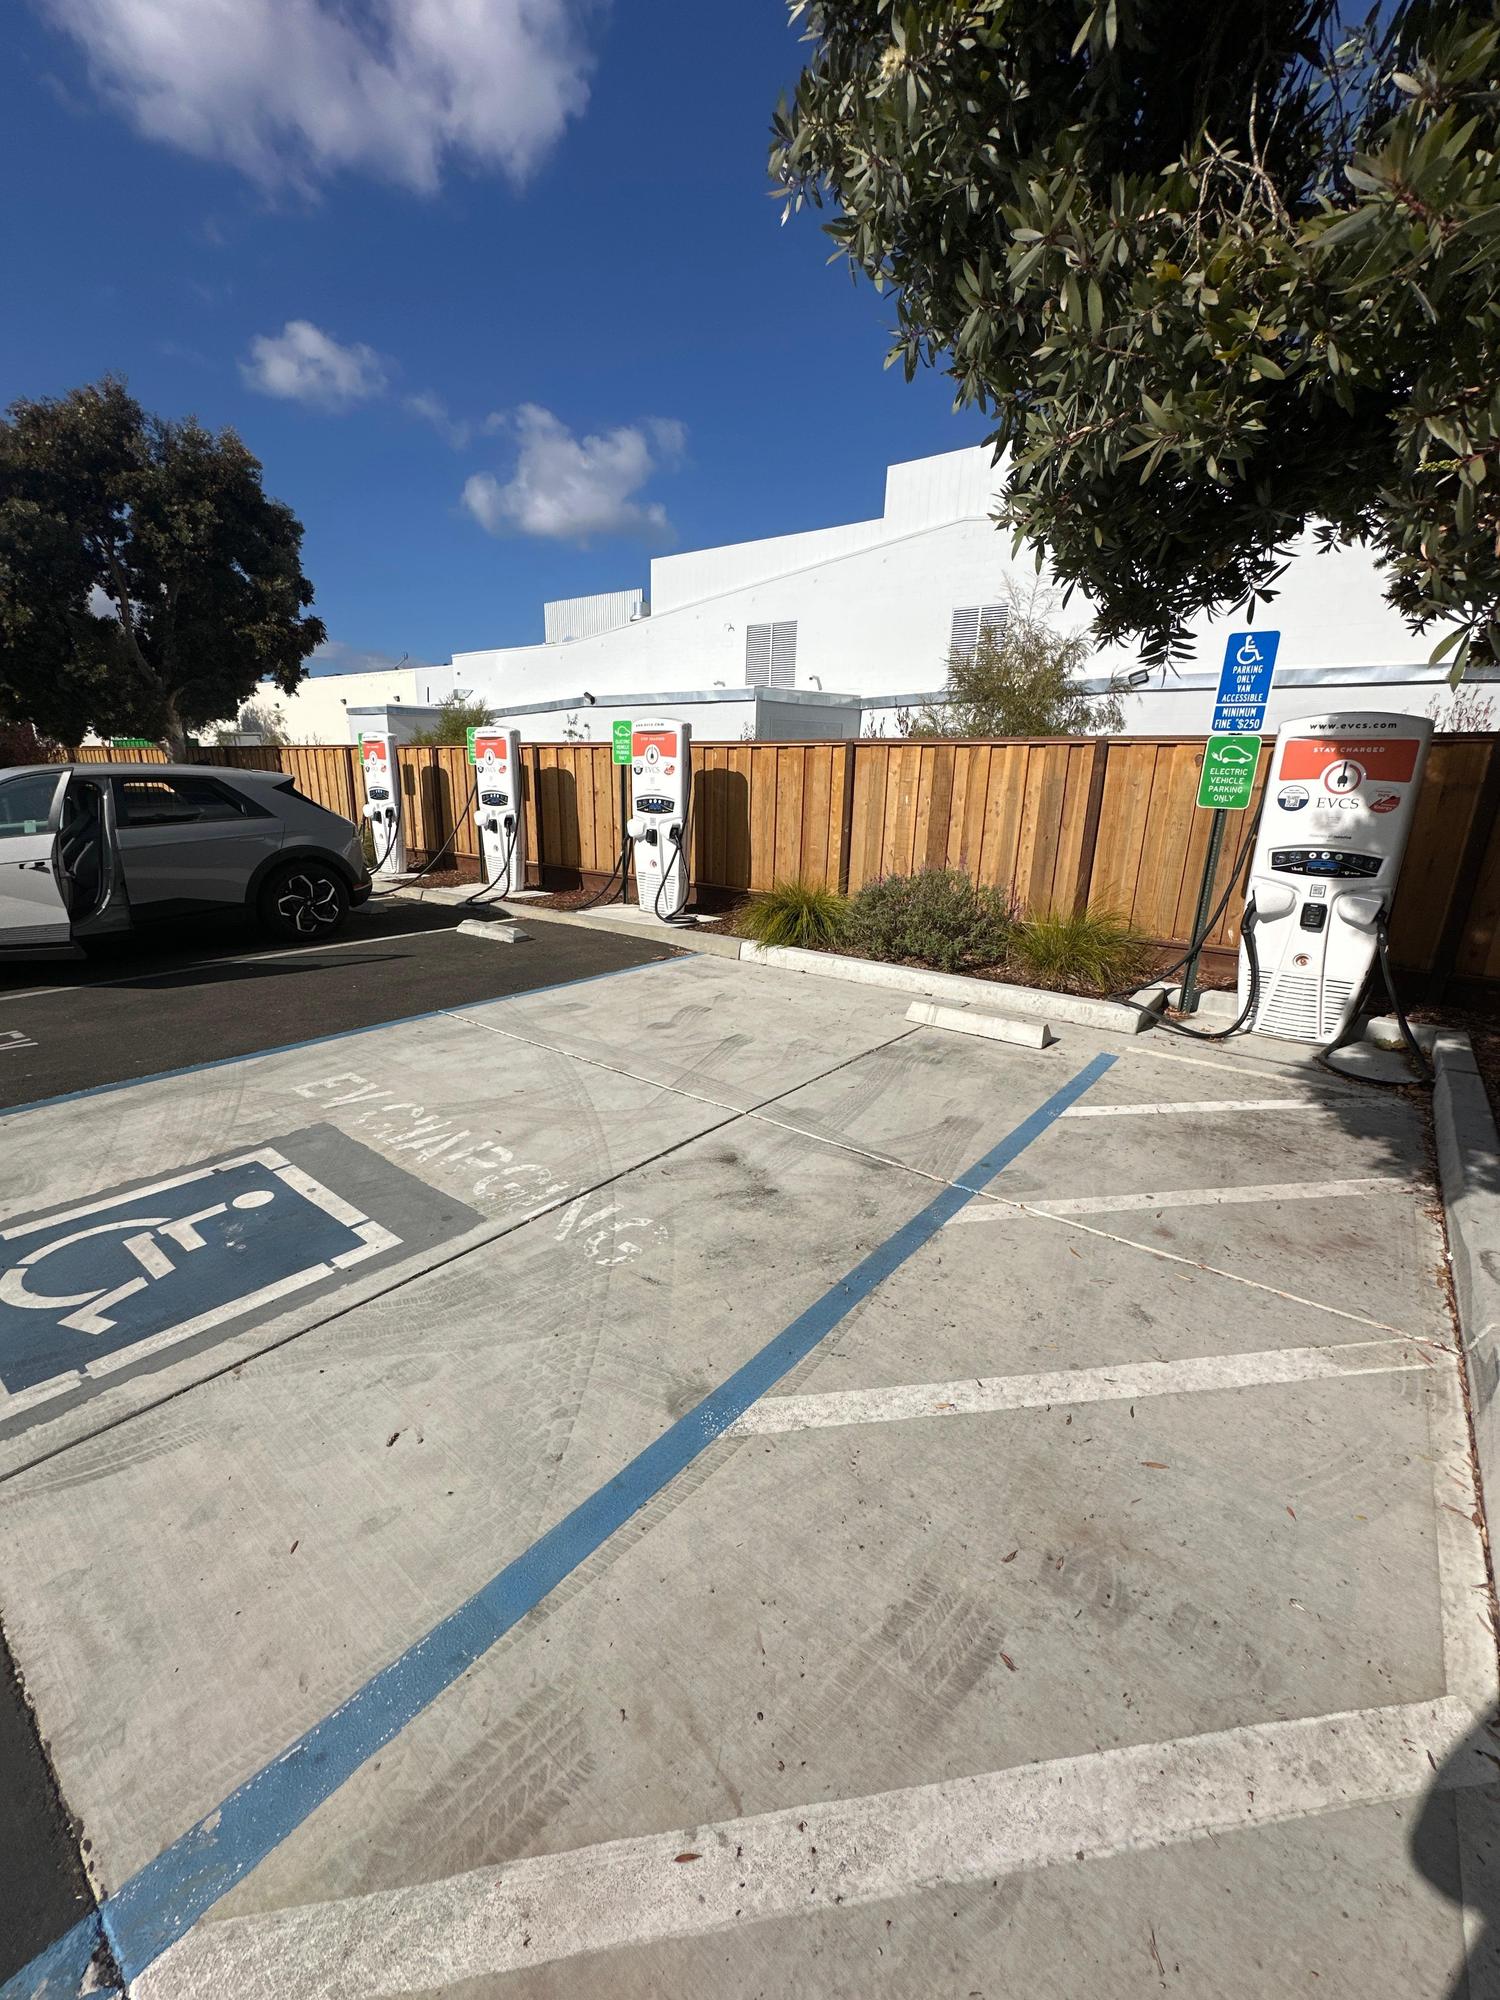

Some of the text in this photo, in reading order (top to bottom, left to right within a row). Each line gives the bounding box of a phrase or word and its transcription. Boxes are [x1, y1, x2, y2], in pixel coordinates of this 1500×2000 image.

[1232, 664, 1263, 674] PARKING
[1236, 674, 1256, 684] ONLY
[1237, 684, 1251, 693] VAN
[1221, 693, 1263, 702] ACCESSIBLE
[1221, 707, 1257, 717] MINIMUM
[1214, 718, 1260, 729] FINE $250
[1310, 722, 1397, 730] www.evcs.com
[1209, 767, 1248, 776] ELECTRIC
[1210, 776, 1245, 785] VEHICLE
[1208, 785, 1244, 794] PARKING
[1213, 794, 1235, 803] ONLY
[1316, 797, 1360, 809] EVCS
[291, 1072, 669, 1267] EV CHARGING
